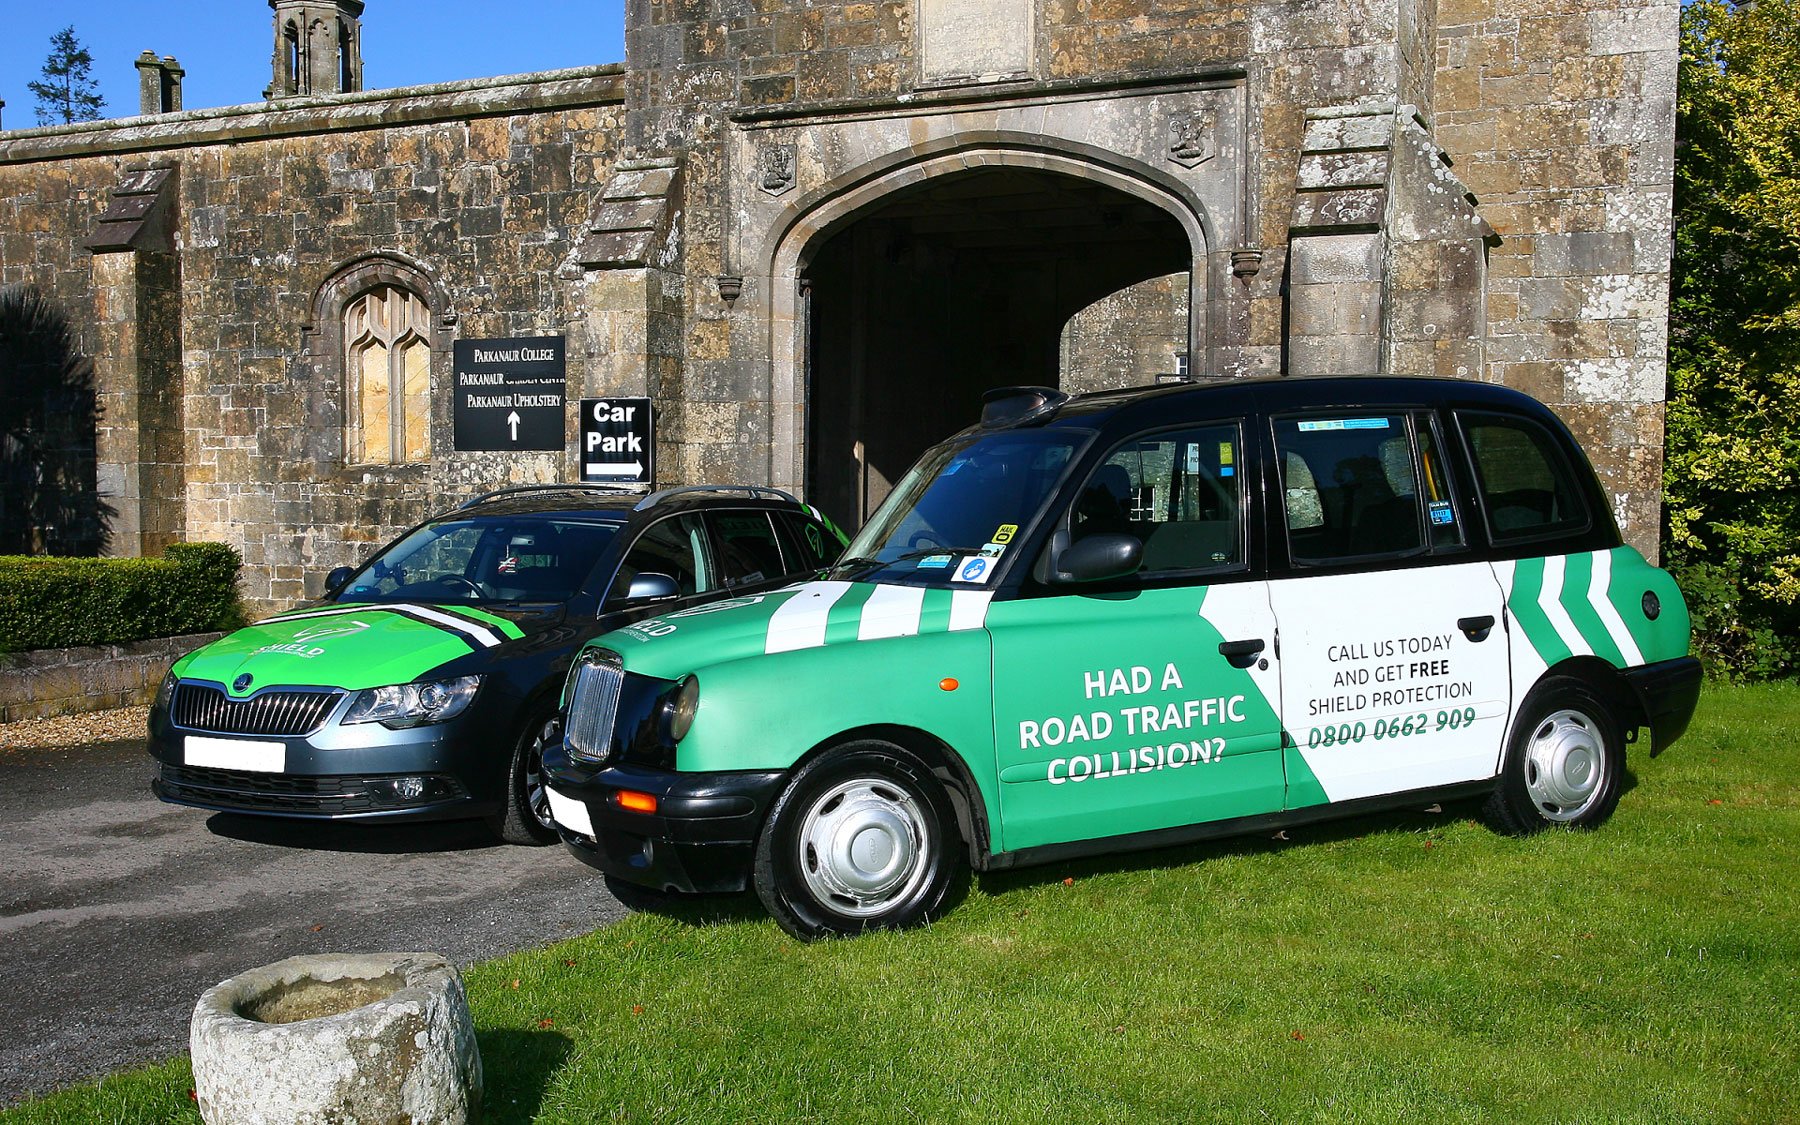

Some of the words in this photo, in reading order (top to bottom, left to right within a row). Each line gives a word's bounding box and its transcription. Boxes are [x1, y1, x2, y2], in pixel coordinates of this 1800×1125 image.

[521, 347, 554, 362] COLLEGE
[593, 401, 636, 423] Car
[587, 431, 642, 453] Park
[1327, 643, 1369, 662] CALL
[1373, 640, 1394, 658] US
[1398, 634, 1452, 655] TODAY
[1083, 665, 1152, 699] HAD
[1160, 662, 1184, 691] A
[1333, 668, 1370, 688] AND
[1375, 664, 1405, 683] GET
[1410, 659, 1450, 679] FREE
[1309, 694, 1367, 716] SHIELD
[1372, 681, 1472, 708] PROTECTION
[1019, 711, 1113, 749] ROAD
[1120, 695, 1246, 735] TRAFFIC
[1308, 721, 1366, 749] 0800
[1373, 713, 1428, 740] 0662
[1436, 707, 1476, 732] 909
[1047, 737, 1227, 785] COLLISION?
